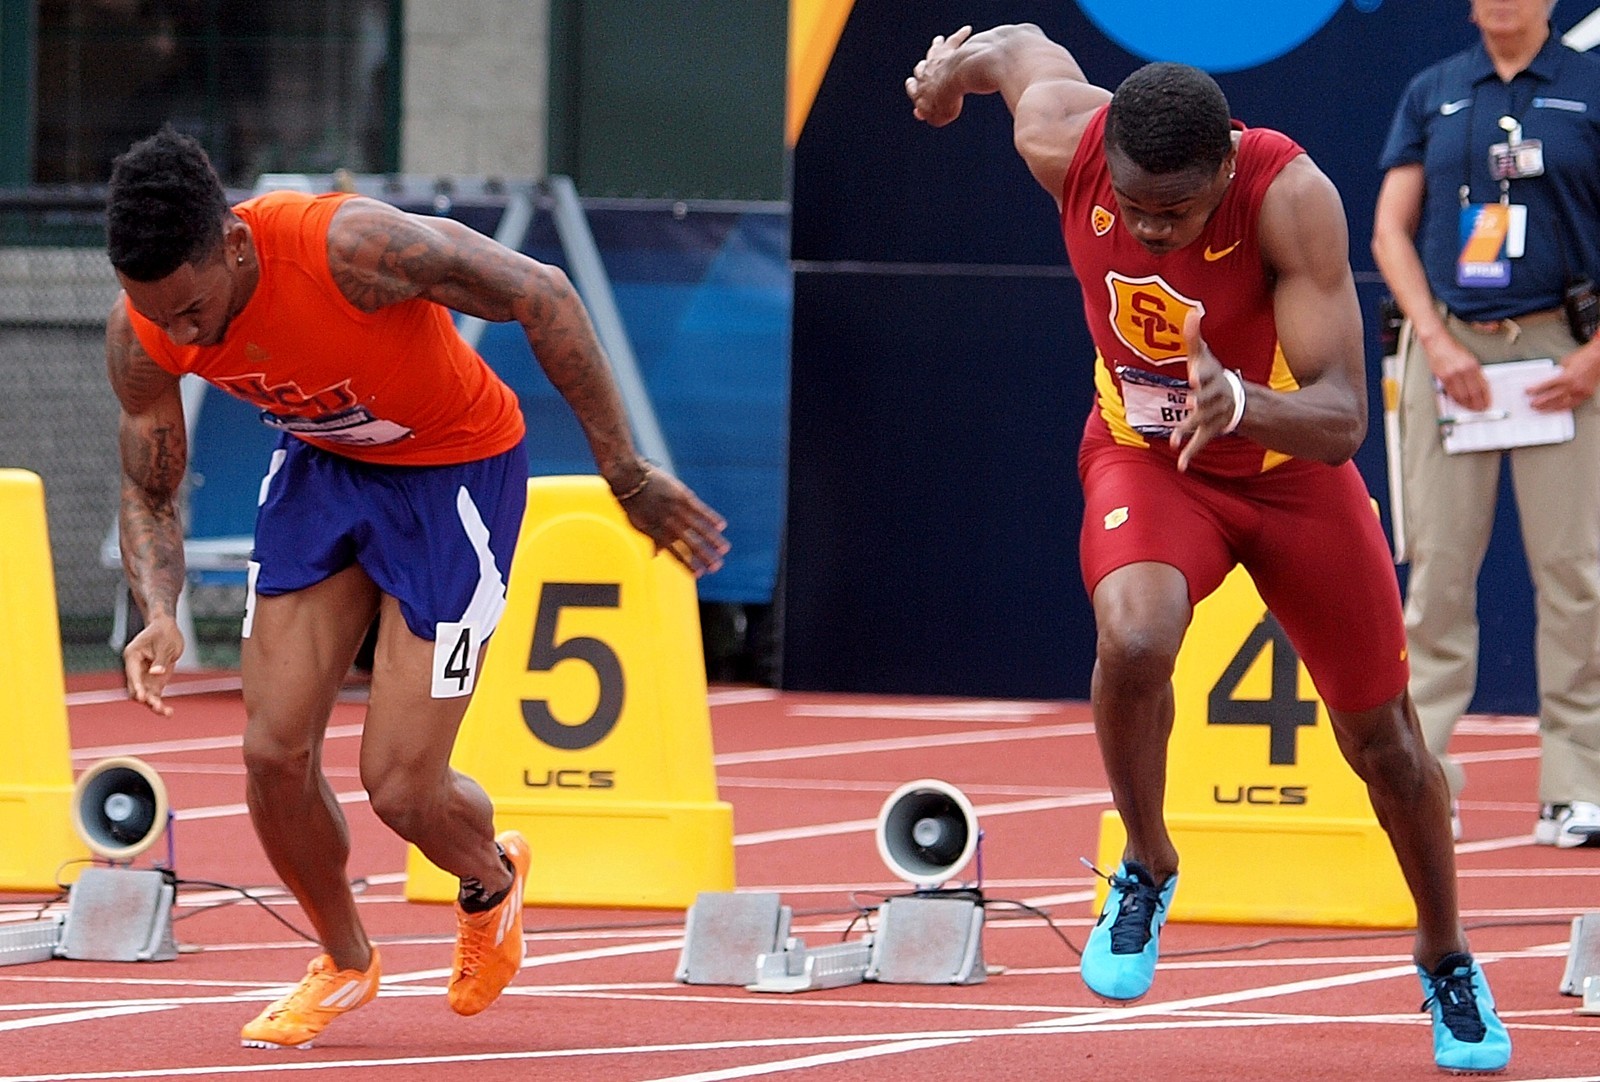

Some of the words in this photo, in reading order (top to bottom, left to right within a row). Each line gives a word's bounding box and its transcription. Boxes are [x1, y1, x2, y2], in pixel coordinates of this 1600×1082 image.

[1131, 292, 1181, 351] SC
[444, 627, 470, 691] 4
[520, 582, 625, 750] 5
[1208, 609, 1317, 765] 4
[524, 770, 615, 788] UCS
[1214, 785, 1307, 805] UCS
